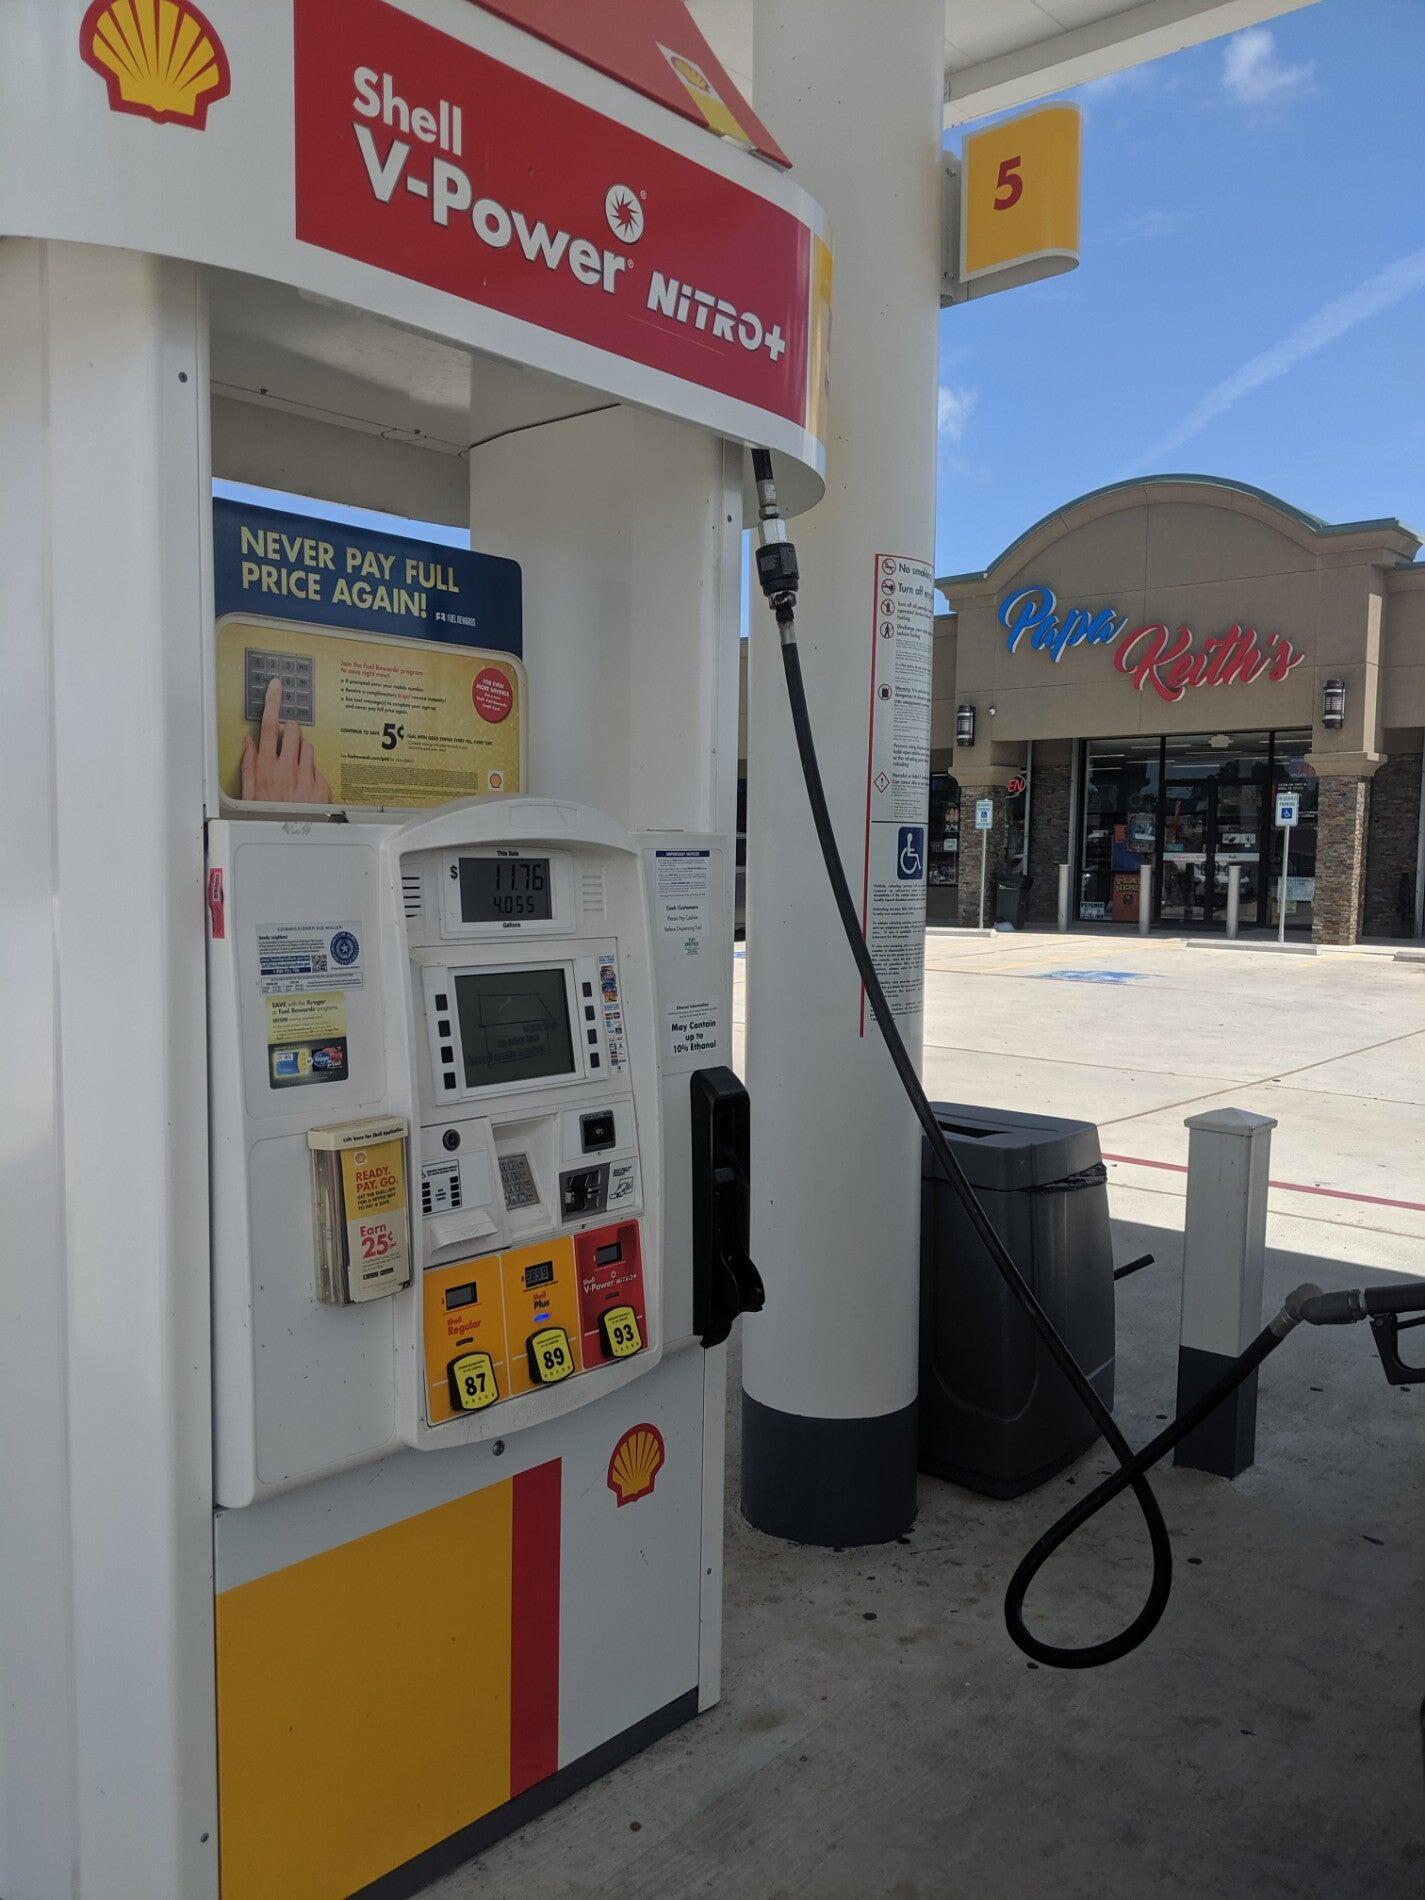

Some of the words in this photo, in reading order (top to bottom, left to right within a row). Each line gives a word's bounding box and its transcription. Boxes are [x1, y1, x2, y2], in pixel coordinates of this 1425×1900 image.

[352, 66, 462, 155] Shell
[994, 156, 1023, 210] 5
[241, 526, 335, 570] NEVER
[346, 547, 396, 580] PAY
[406, 559, 459, 593] FULL
[899, 563, 910, 574] No
[241, 562, 320, 600] PRICE
[332, 579, 427, 619] AGAIN!
[898, 583, 913, 594] Turn
[998, 585, 1128, 663] Papa
[1113, 624, 1305, 701] Keith's
[363, 662, 374, 670] Fuel
[375, 665, 399, 673] Rewards
[400, 668, 423, 676] program
[1008, 779, 1023, 792] EN
[450, 865, 458, 880] $
[496, 864, 544, 890] 11.76
[672, 1024, 687, 1032] May
[690, 1020, 716, 1029] Contain
[674, 1044, 688, 1053] 10%
[691, 1040, 716, 1050] Ethanol
[356, 1166, 391, 1182] READY.
[357, 1180, 378, 1192] PAY.
[380, 1176, 398, 1187] GO.
[360, 1224, 386, 1236] Earn
[362, 1231, 393, 1258] 25¢
[583, 1277, 595, 1285] Shell
[584, 1281, 614, 1294] V-Power
[534, 1292, 546, 1300] Shell
[534, 1299, 550, 1310] Plus
[448, 1316, 462, 1326] Shell
[448, 1321, 481, 1336] Regular
[614, 1324, 634, 1345] 93
[543, 1347, 564, 1370] 89
[465, 1372, 485, 1396] 87
